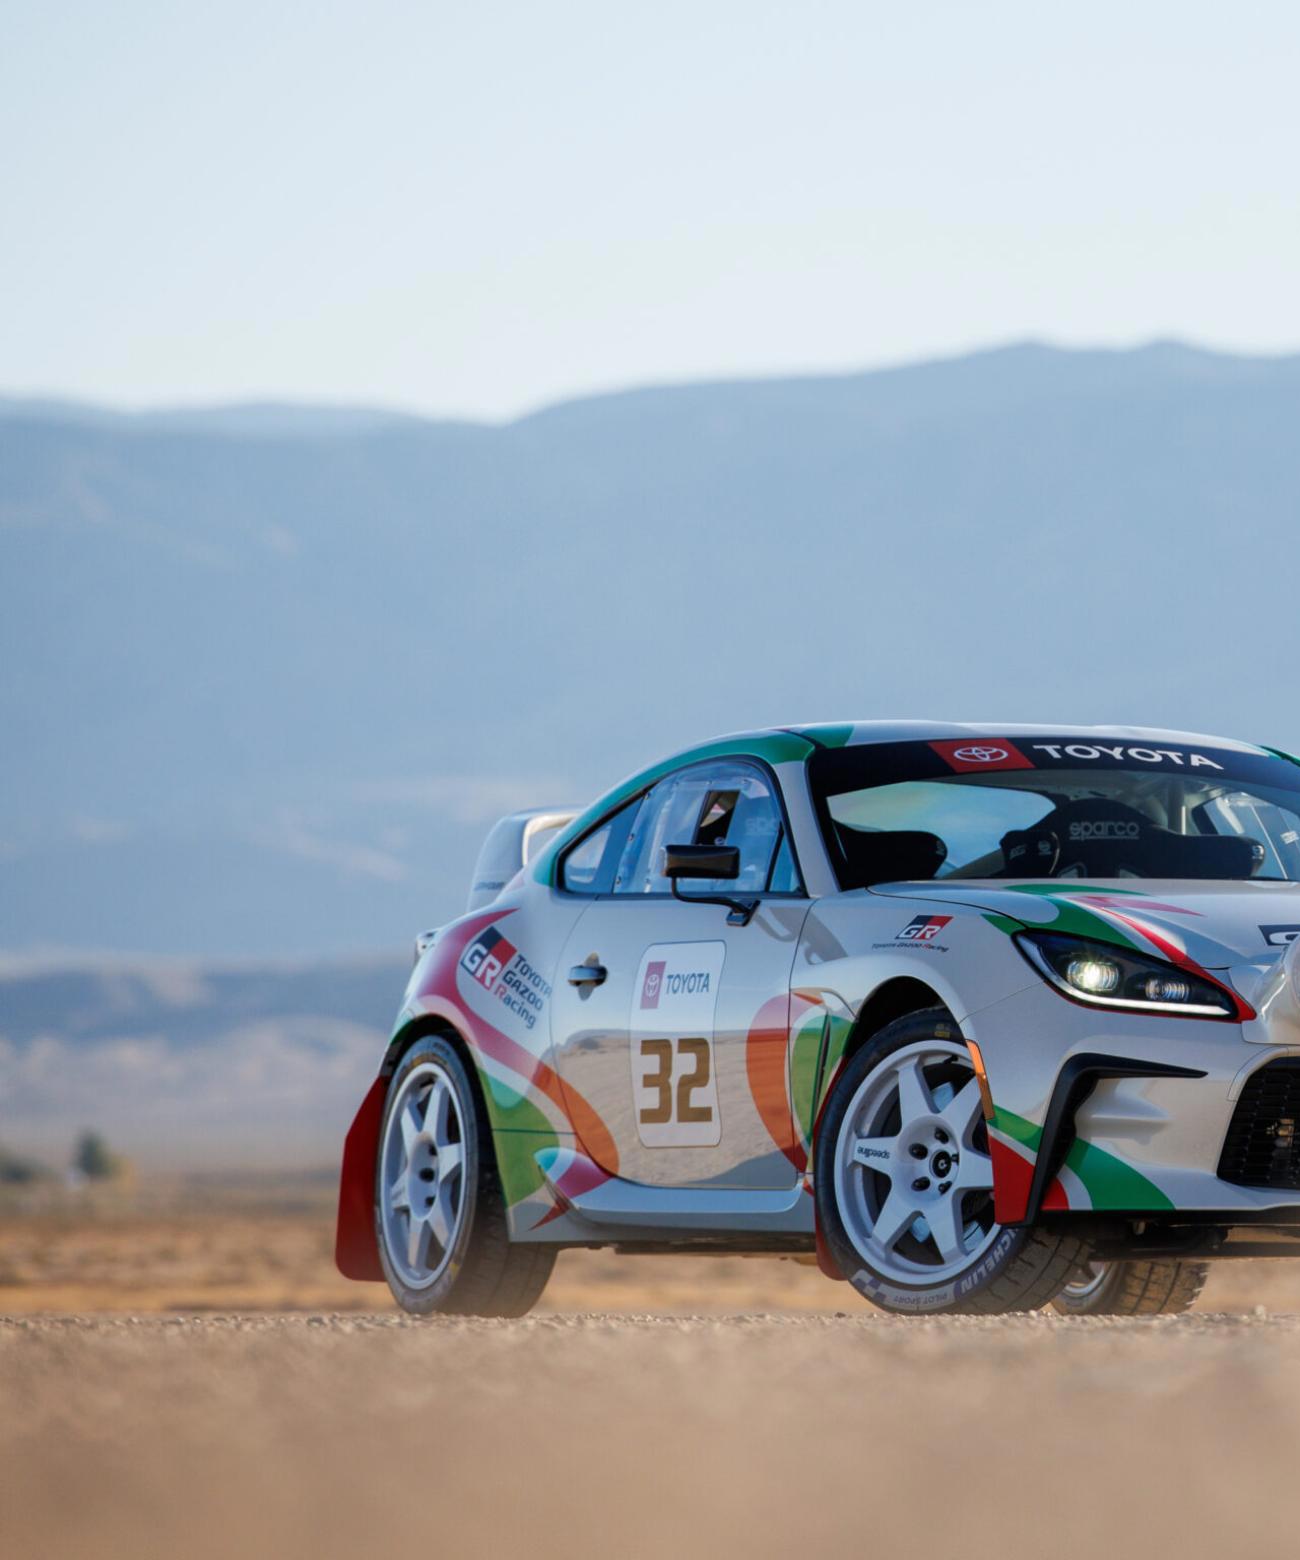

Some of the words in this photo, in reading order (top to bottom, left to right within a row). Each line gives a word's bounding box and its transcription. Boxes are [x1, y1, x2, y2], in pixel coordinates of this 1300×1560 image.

[1033, 745, 1224, 770] TOYOTA
[1069, 821, 1139, 840] sparco
[898, 925, 941, 939] GR
[463, 942, 502, 988] GR
[514, 954, 553, 999] TOYOTA
[665, 973, 710, 995] TOYOTA
[494, 983, 536, 1030] Racing
[503, 970, 544, 1011] GAZOO
[640, 1038, 712, 1124] 32
[960, 1227, 1019, 1294] ICHELIN
